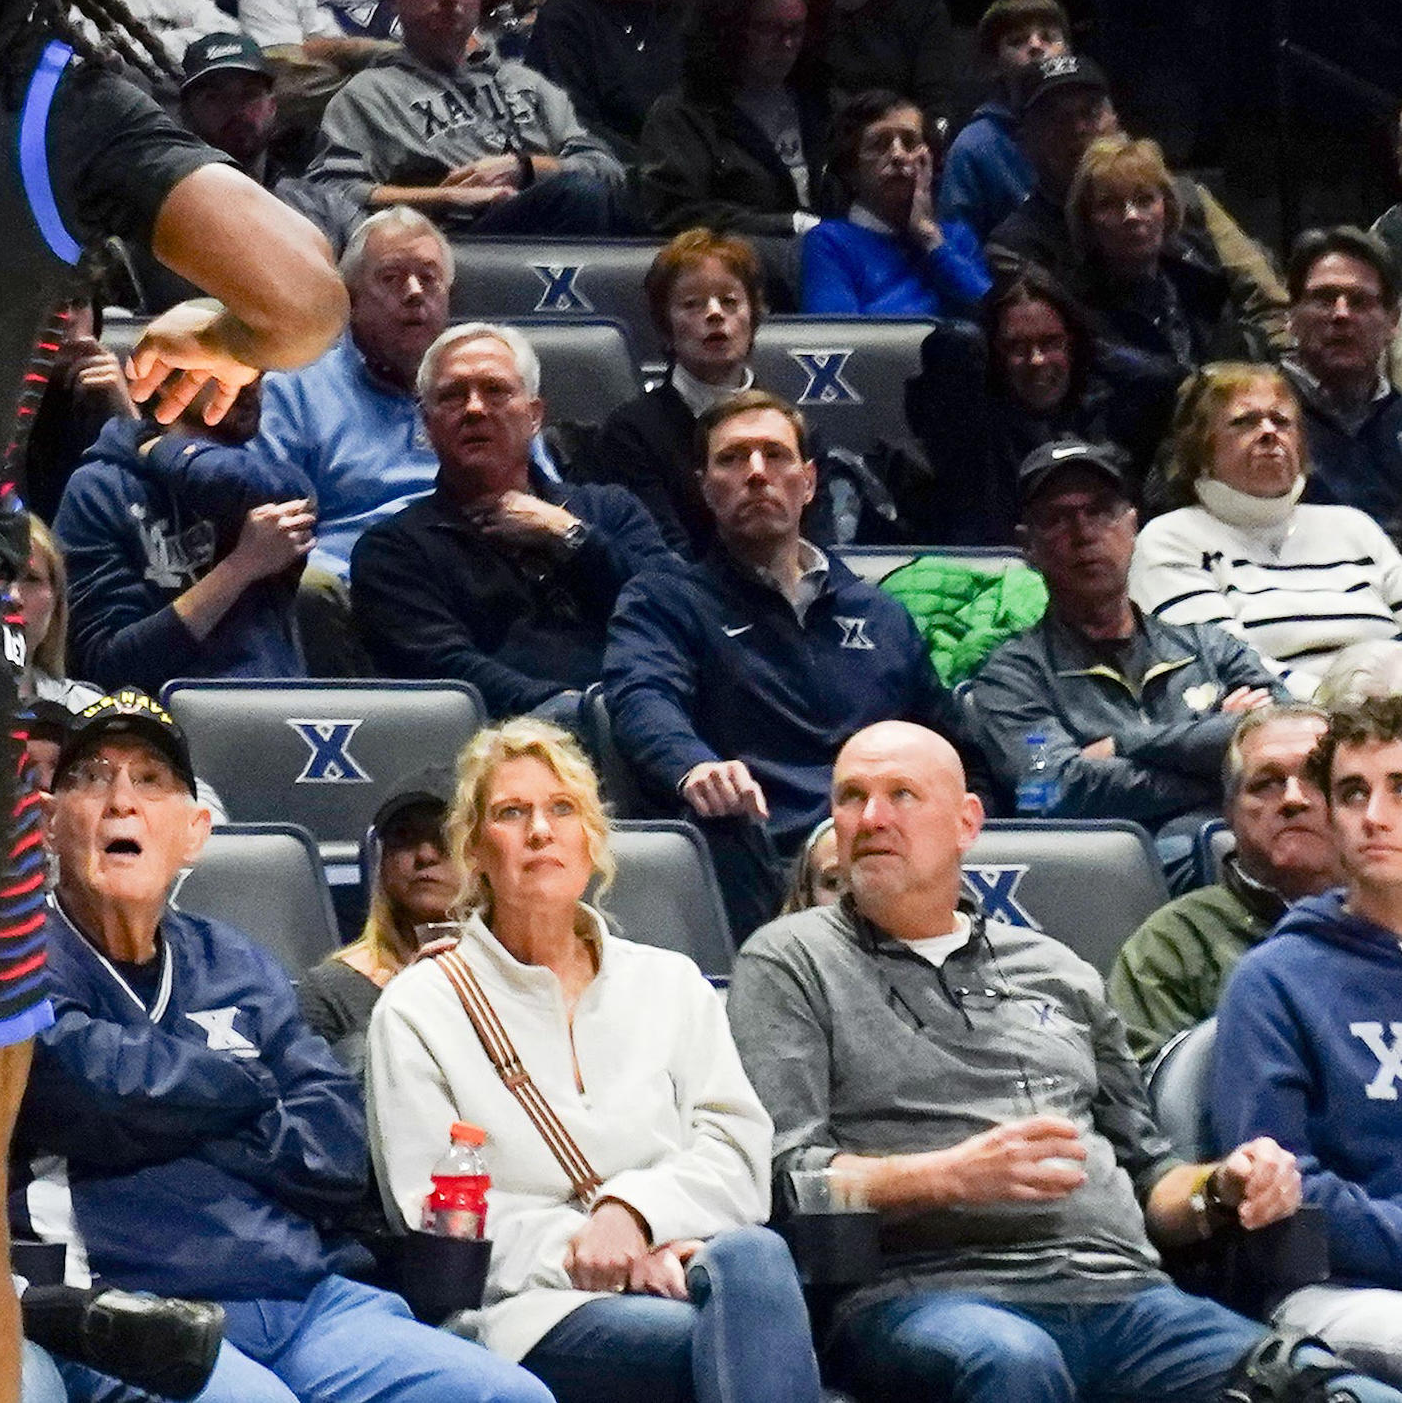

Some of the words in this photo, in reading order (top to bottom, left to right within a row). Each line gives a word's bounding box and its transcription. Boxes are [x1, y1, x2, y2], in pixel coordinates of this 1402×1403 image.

[531, 264, 594, 313] X
[786, 349, 865, 404] X
[286, 718, 374, 784] X
